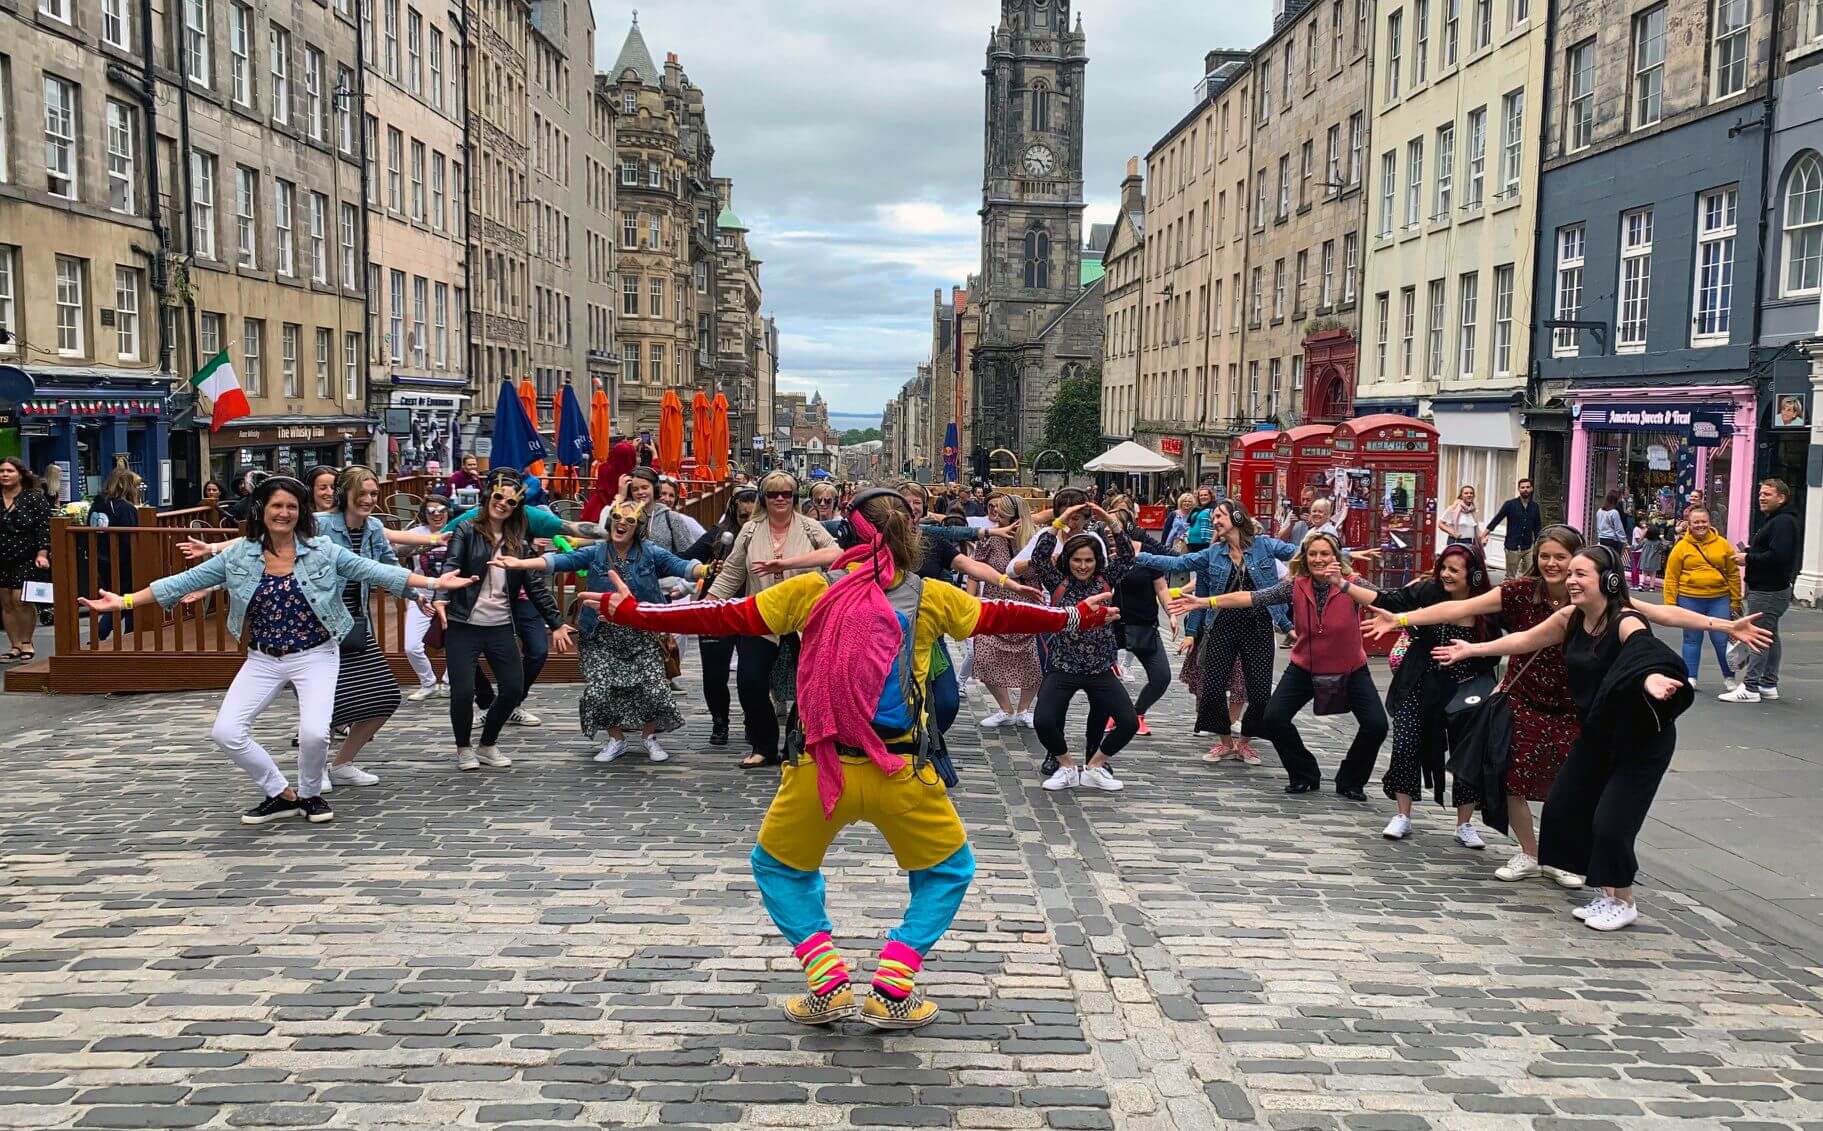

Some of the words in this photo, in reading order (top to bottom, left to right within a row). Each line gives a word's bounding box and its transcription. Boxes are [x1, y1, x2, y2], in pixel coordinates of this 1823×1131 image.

[277, 426, 289, 439] The
[289, 425, 312, 440] Whisky
[312, 425, 325, 437] Trail
[1370, 441, 1425, 450] TELEPHNE
